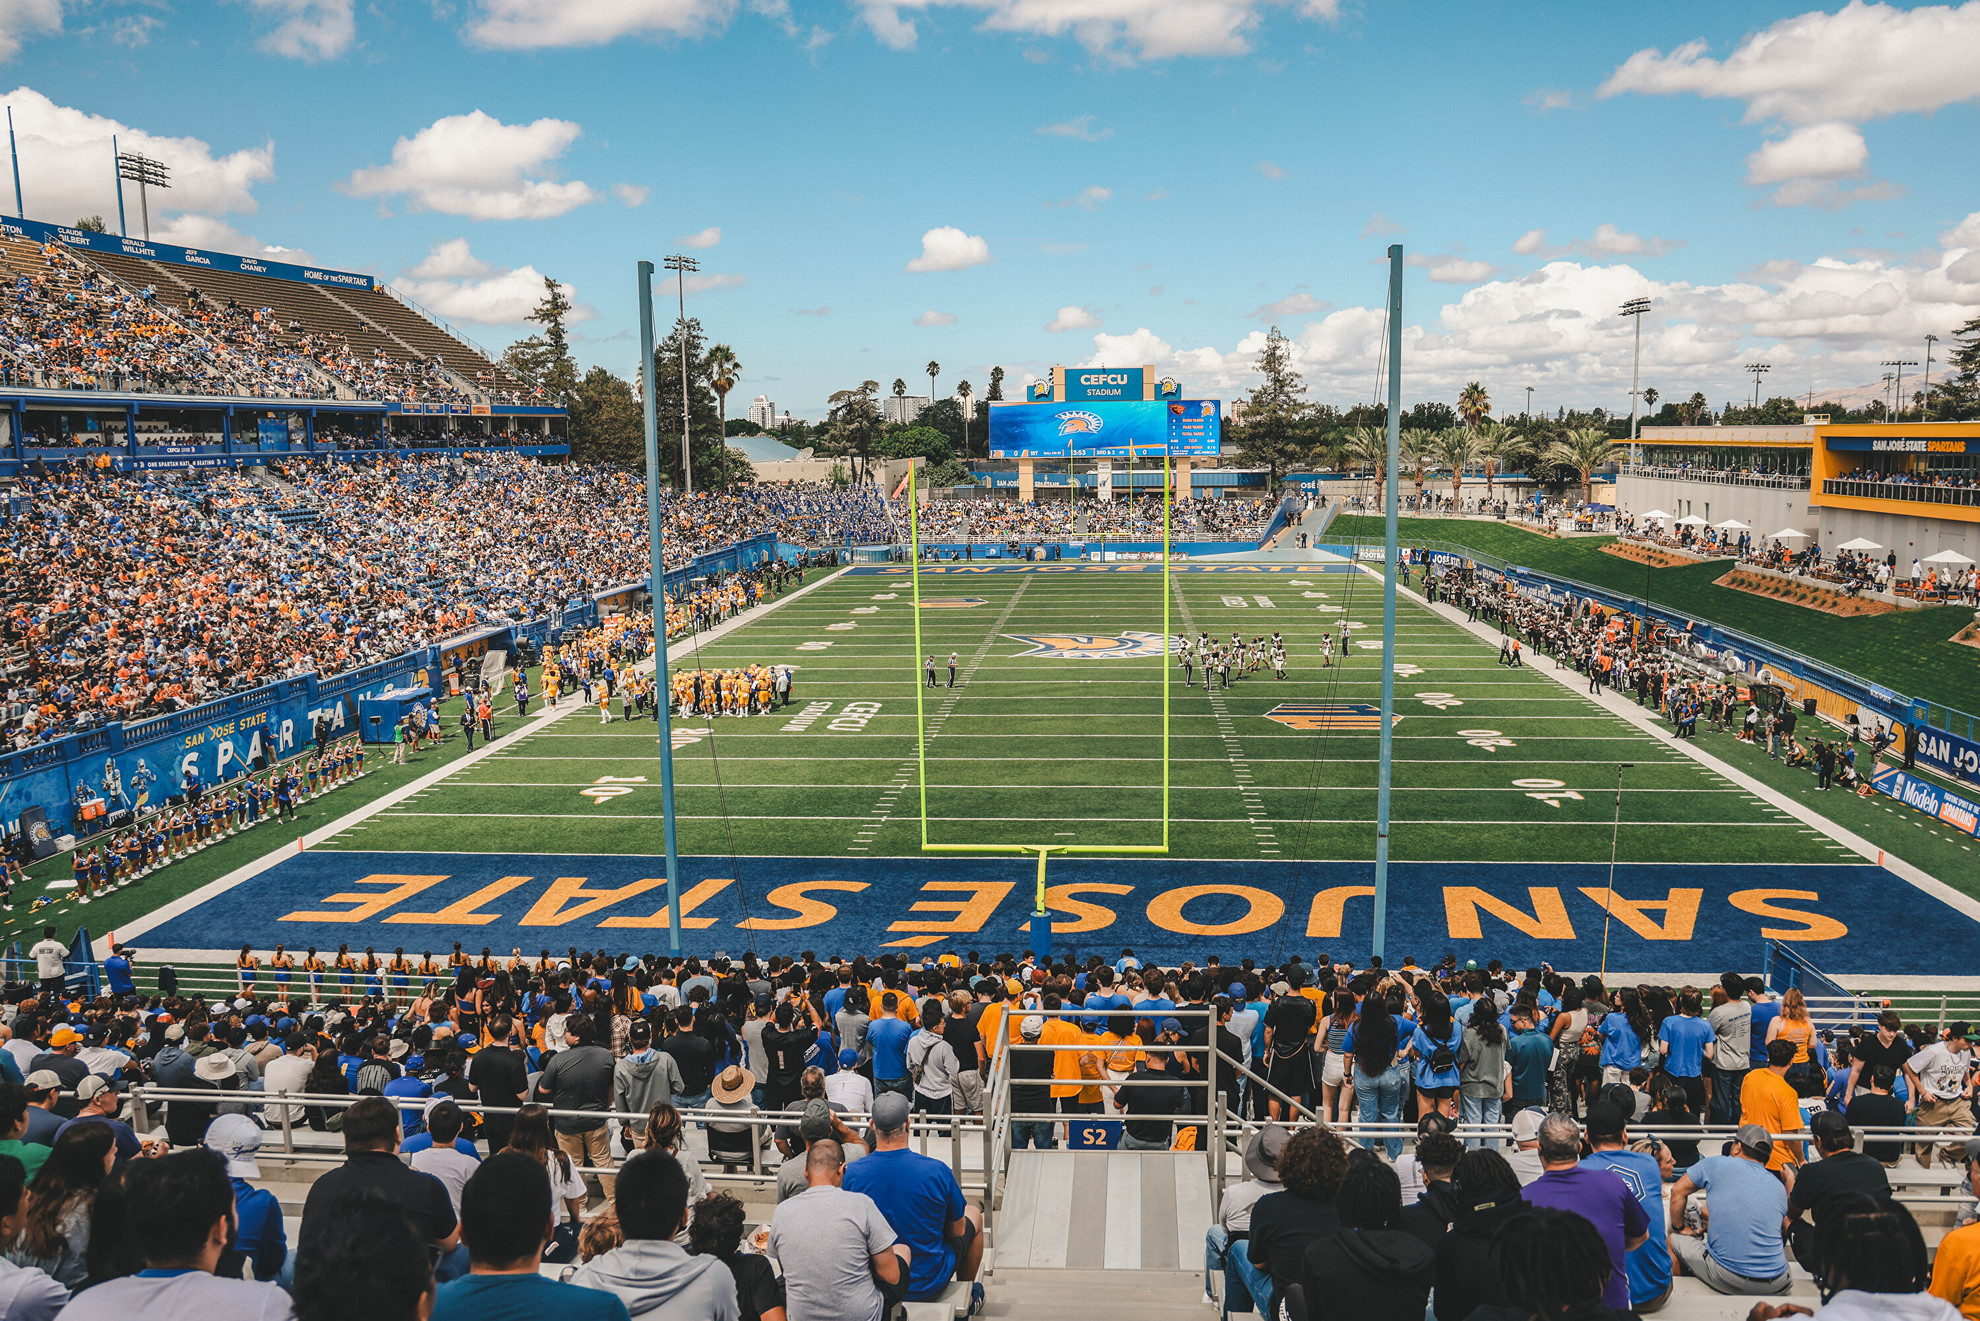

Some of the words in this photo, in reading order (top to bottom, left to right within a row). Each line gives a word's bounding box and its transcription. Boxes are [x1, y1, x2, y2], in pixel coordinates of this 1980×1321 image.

[58, 228, 83, 237] CLAUDE
[122, 238, 145, 248] GERALD
[122, 244, 156, 256] WILLHITE
[186, 255, 211, 265] GARCIA
[240, 263, 267, 273] CHANEY
[304, 270, 323, 280] HOME
[338, 274, 368, 286] SPARTANS
[1080, 374, 1128, 386] CEFCU
[1873, 440, 1886, 451] SAN
[1887, 438, 1905, 451] JOSÉ
[1905, 441, 1927, 452] STATE
[1927, 441, 1966, 452] SPARTANS
[876, 566, 997, 574] SAN
[1003, 565, 1147, 573] JOSÉ
[1414, 692, 1464, 706] 30
[780, 701, 833, 732] STADIUM
[826, 702, 882, 732] CEFCU
[184, 732, 205, 749] SAN
[210, 718, 235, 741] JOSÉ
[240, 712, 267, 730] STATE
[1456, 730, 1518, 747] 20
[1918, 732, 1950, 764] SAN
[1954, 747, 1980, 778] JO
[579, 776, 648, 796] 10
[1512, 778, 1585, 800] 10
[1903, 780, 1938, 815] Modelo
[1943, 802, 1974, 827] SPARTANS
[277, 873, 872, 930] STATE
[877, 881, 1376, 950] JOSÉ
[1442, 886, 1848, 941] SAN
[777, 1050, 784, 1069] 1
[1082, 1128, 1106, 1145] S2
